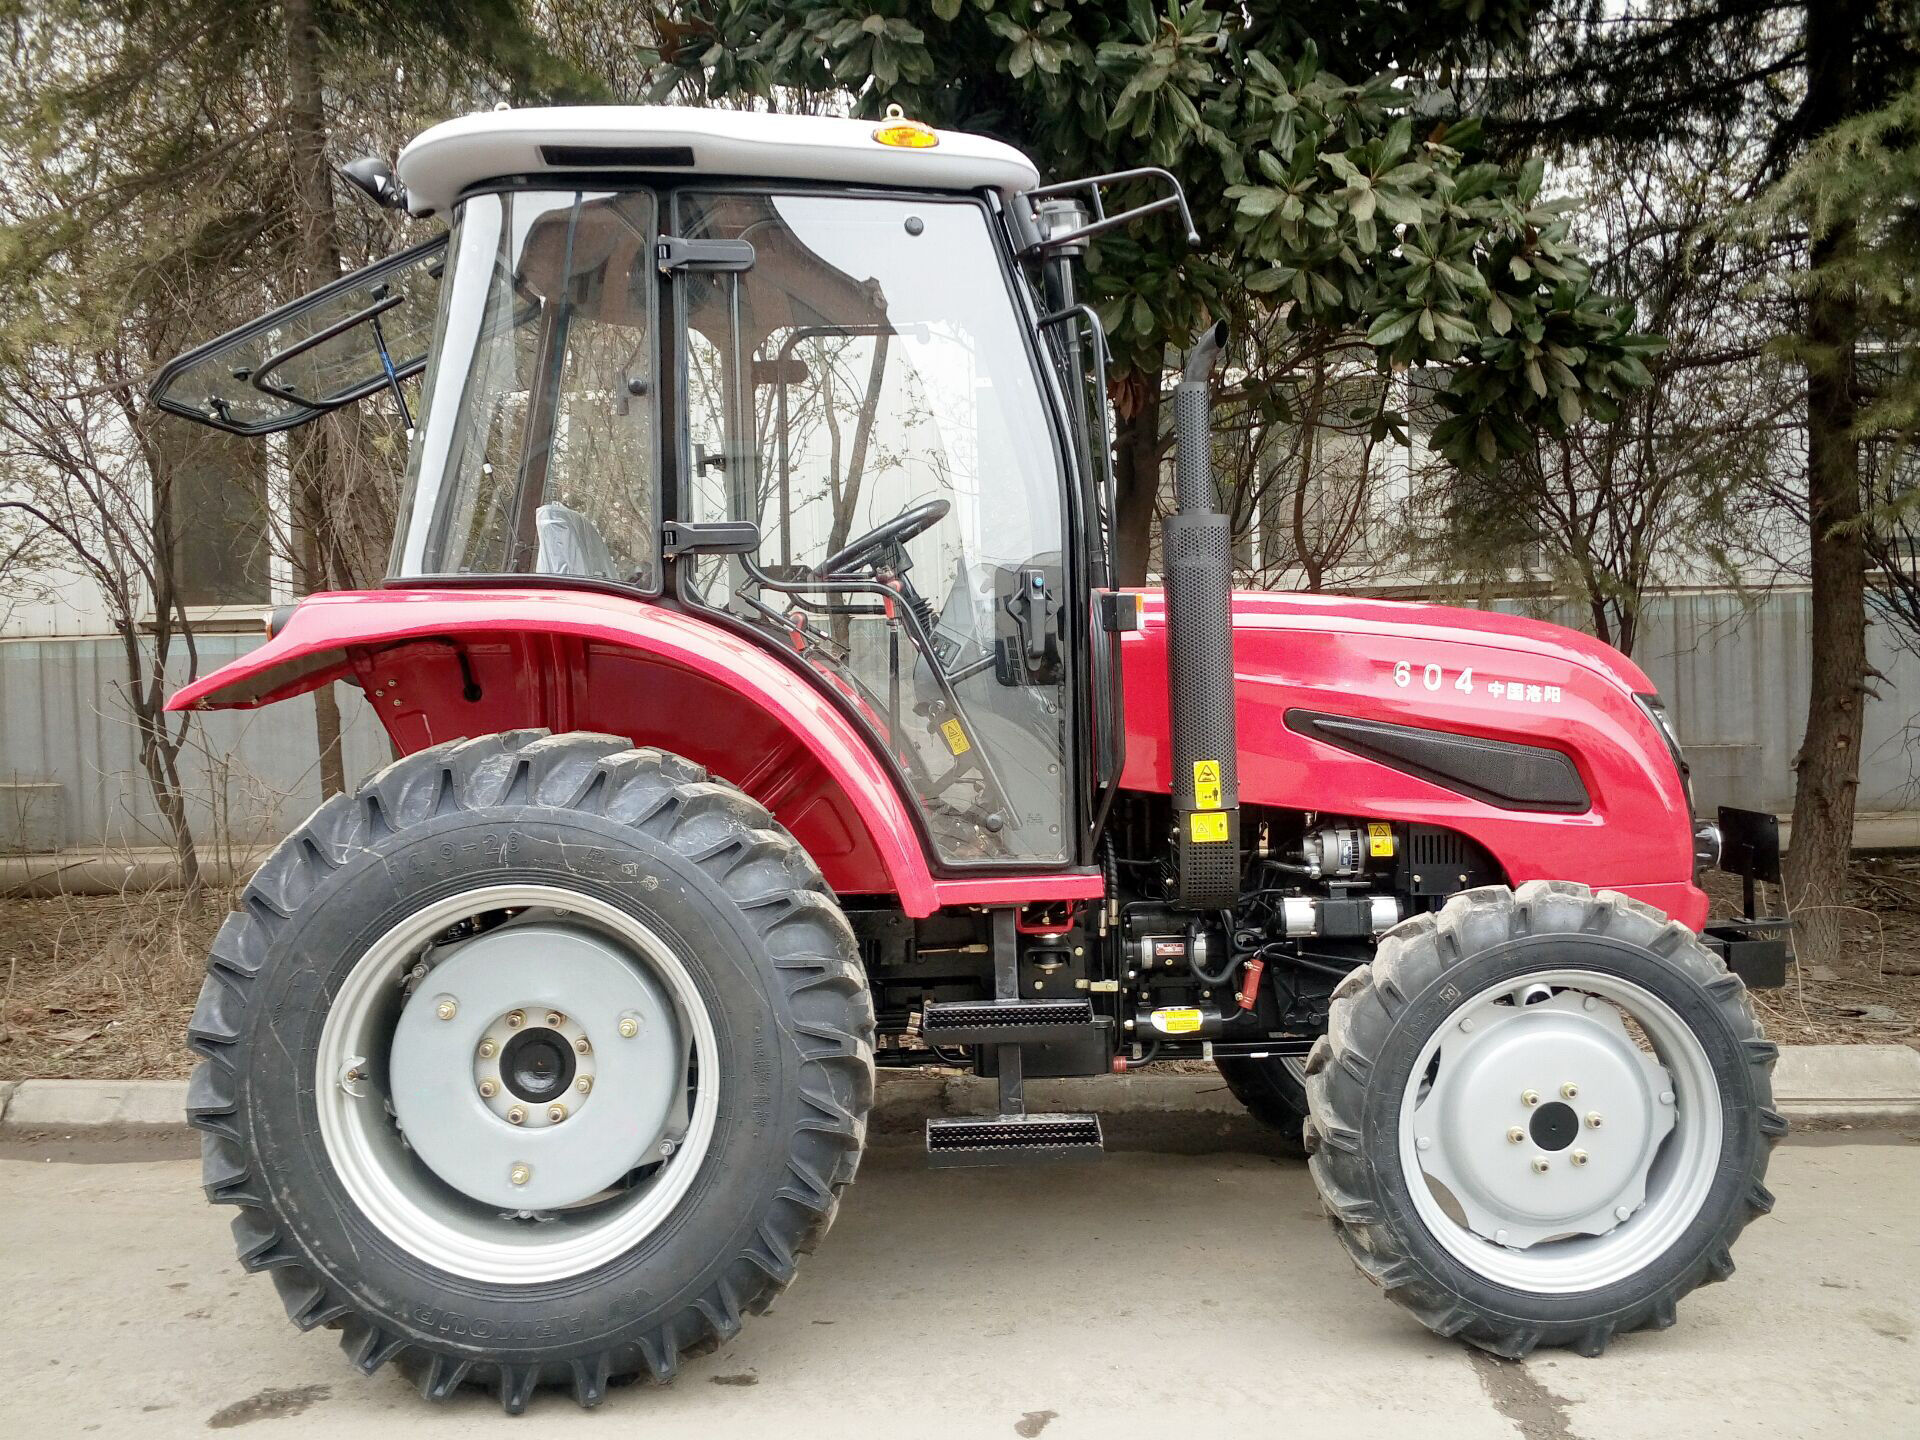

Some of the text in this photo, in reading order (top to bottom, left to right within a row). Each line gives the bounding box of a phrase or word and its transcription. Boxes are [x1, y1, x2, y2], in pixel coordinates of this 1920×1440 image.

[1393, 661, 1474, 695] 604
[1487, 680, 1561, 703] 中国洛阳
